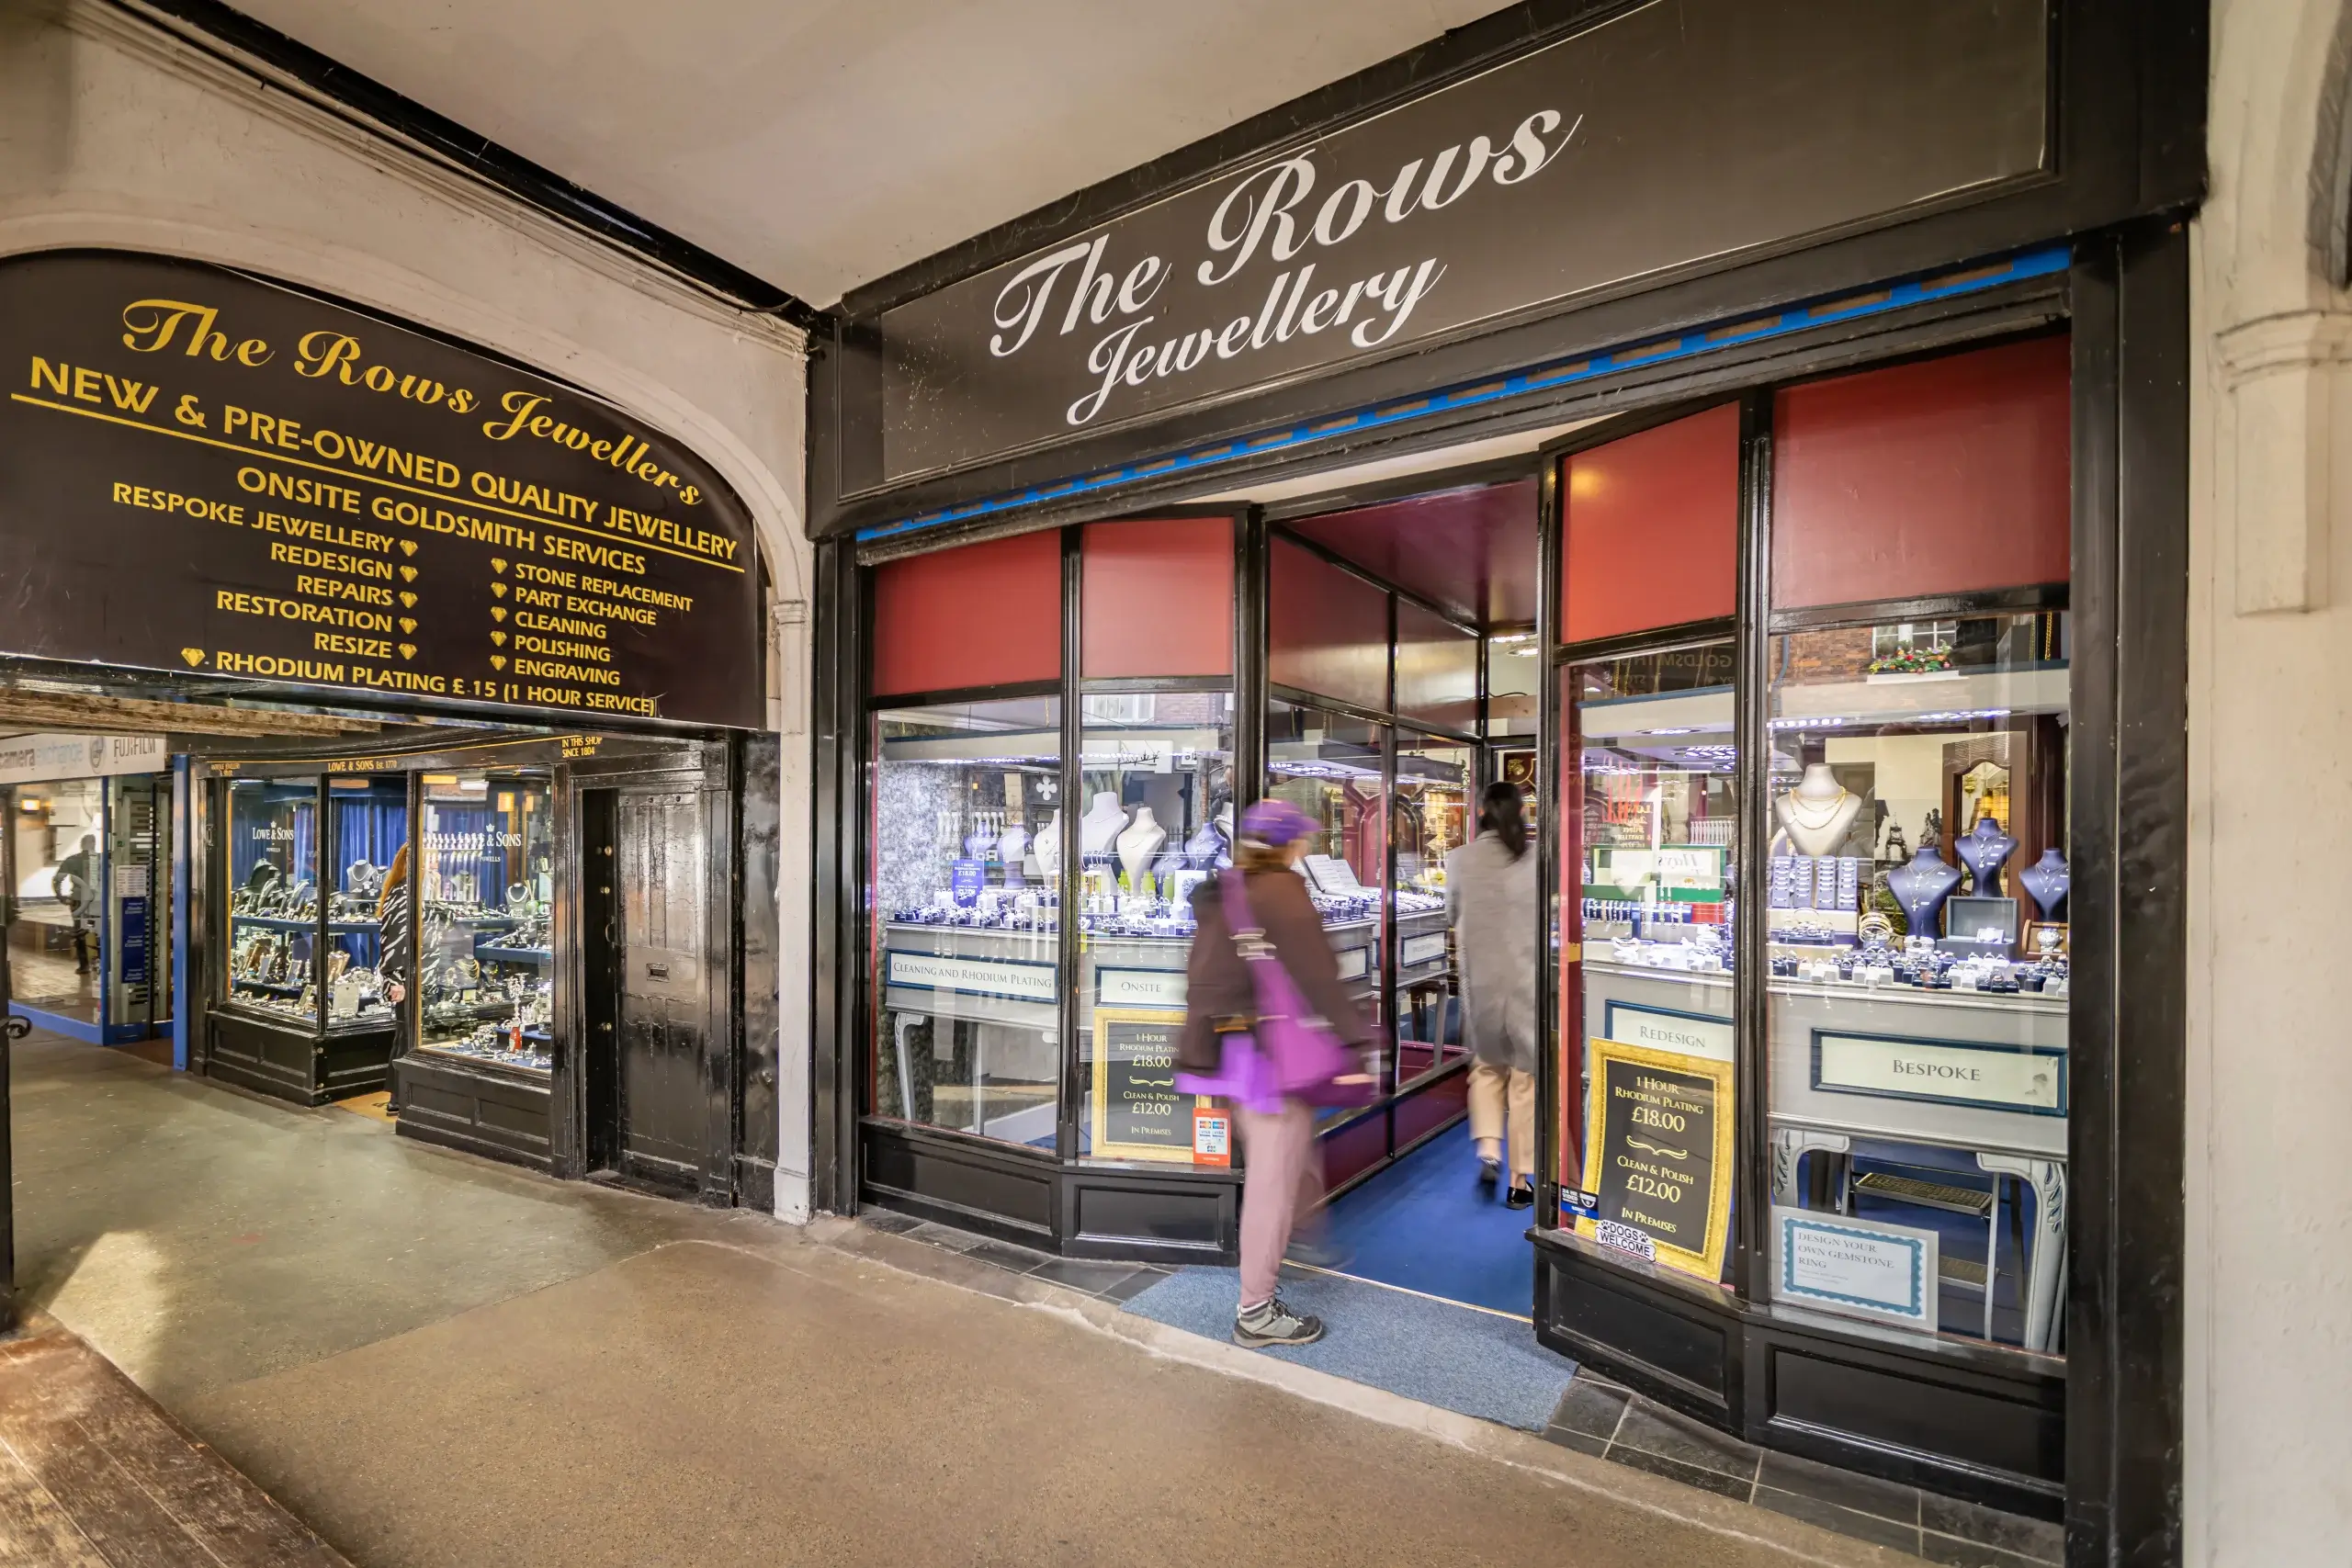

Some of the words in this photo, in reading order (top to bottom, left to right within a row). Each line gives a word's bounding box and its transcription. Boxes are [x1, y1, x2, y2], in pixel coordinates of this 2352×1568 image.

[989, 232, 1171, 356] The
[1196, 109, 1583, 286] Rows
[1066, 257, 1448, 425] Jewellery
[122, 299, 275, 366] The
[294, 331, 481, 413] Rows
[482, 390, 704, 505] Jewellers
[30, 355, 159, 413] NEW
[175, 394, 207, 428] &
[223, 404, 460, 488] PRE-OWNED
[471, 471, 598, 522] QUALITY
[604, 507, 737, 560] JEWELLERY
[113, 482, 243, 525] RESPOKE
[251, 510, 394, 553] JEWELLERY
[237, 467, 361, 514] ONSITE
[371, 497, 535, 551] GOLDSMITH
[543, 535, 645, 575] SERVICES
[270, 542, 392, 581] REDESIGN
[297, 574, 393, 606] REPAIRS
[514, 562, 576, 589] STONE
[582, 575, 693, 612] REPLACEMENT
[217, 590, 392, 632] RESTORATION
[514, 586, 562, 608] PART
[567, 596, 657, 626] EXCHANGE
[514, 611, 607, 639] CLEANING
[314, 633, 392, 659] RESIZE
[514, 635, 611, 662] POLISHING
[217, 651, 344, 682] RHODIUM
[353, 666, 445, 693] PLATING
[503, 682, 519, 703] (1
[527, 686, 581, 706] HOUR
[585, 692, 656, 716] SERVICE)
[514, 659, 620, 685] ENGRAVING
[562, 739, 569, 748] IN
[571, 738, 583, 747] THIS
[562, 748, 579, 758] SINCE
[328, 761, 345, 772] LOWE
[348, 761, 354, 771] &
[356, 761, 374, 771] SONS
[277, 827, 294, 840] SONS
[487, 834, 494, 846] &
[496, 831, 521, 846] SONS
[893, 962, 937, 976] CLEANING
[938, 969, 958, 978] AND
[962, 970, 1007, 983] RHODIUM
[1011, 975, 1052, 987] PLATING
[1121, 982, 1161, 992] ONSITE
[1120, 1043, 1153, 1052] RHODIUM
[1142, 1033, 1167, 1043] HOUR
[1640, 1025, 1705, 1047] REDESIGN
[1133, 1055, 1171, 1067] £18.00
[1893, 1059, 1981, 1081] BESPOKE
[1124, 1091, 1147, 1100] CLEAN
[1157, 1093, 1180, 1101] POLISH
[1636, 1077, 1641, 1086] 1
[1644, 1077, 1679, 1095] HOUR
[1132, 1102, 1171, 1115] £12.00
[1615, 1087, 1660, 1105] RHODIUM
[1663, 1096, 1703, 1114] PLATING
[1142, 1127, 1171, 1135] PREMISES
[1631, 1106, 1685, 1133] £18.00
[1617, 1156, 1648, 1172] CLEAN
[1649, 1166, 1657, 1175] &
[1661, 1167, 1693, 1184] POLISH
[1625, 1174, 1680, 1202] £12.00
[1610, 1224, 1638, 1240] DOGS
[1622, 1207, 1633, 1219] IN
[1634, 1211, 1677, 1233] PREMISES
[1600, 1232, 1650, 1257] WELCOME
[1798, 1233, 1840, 1246] DESIGN
[1843, 1240, 1877, 1253] YOUR
[1798, 1245, 1826, 1257] OWN
[1828, 1250, 1894, 1269] GEMSTONE
[1798, 1257, 1826, 1269] RING
